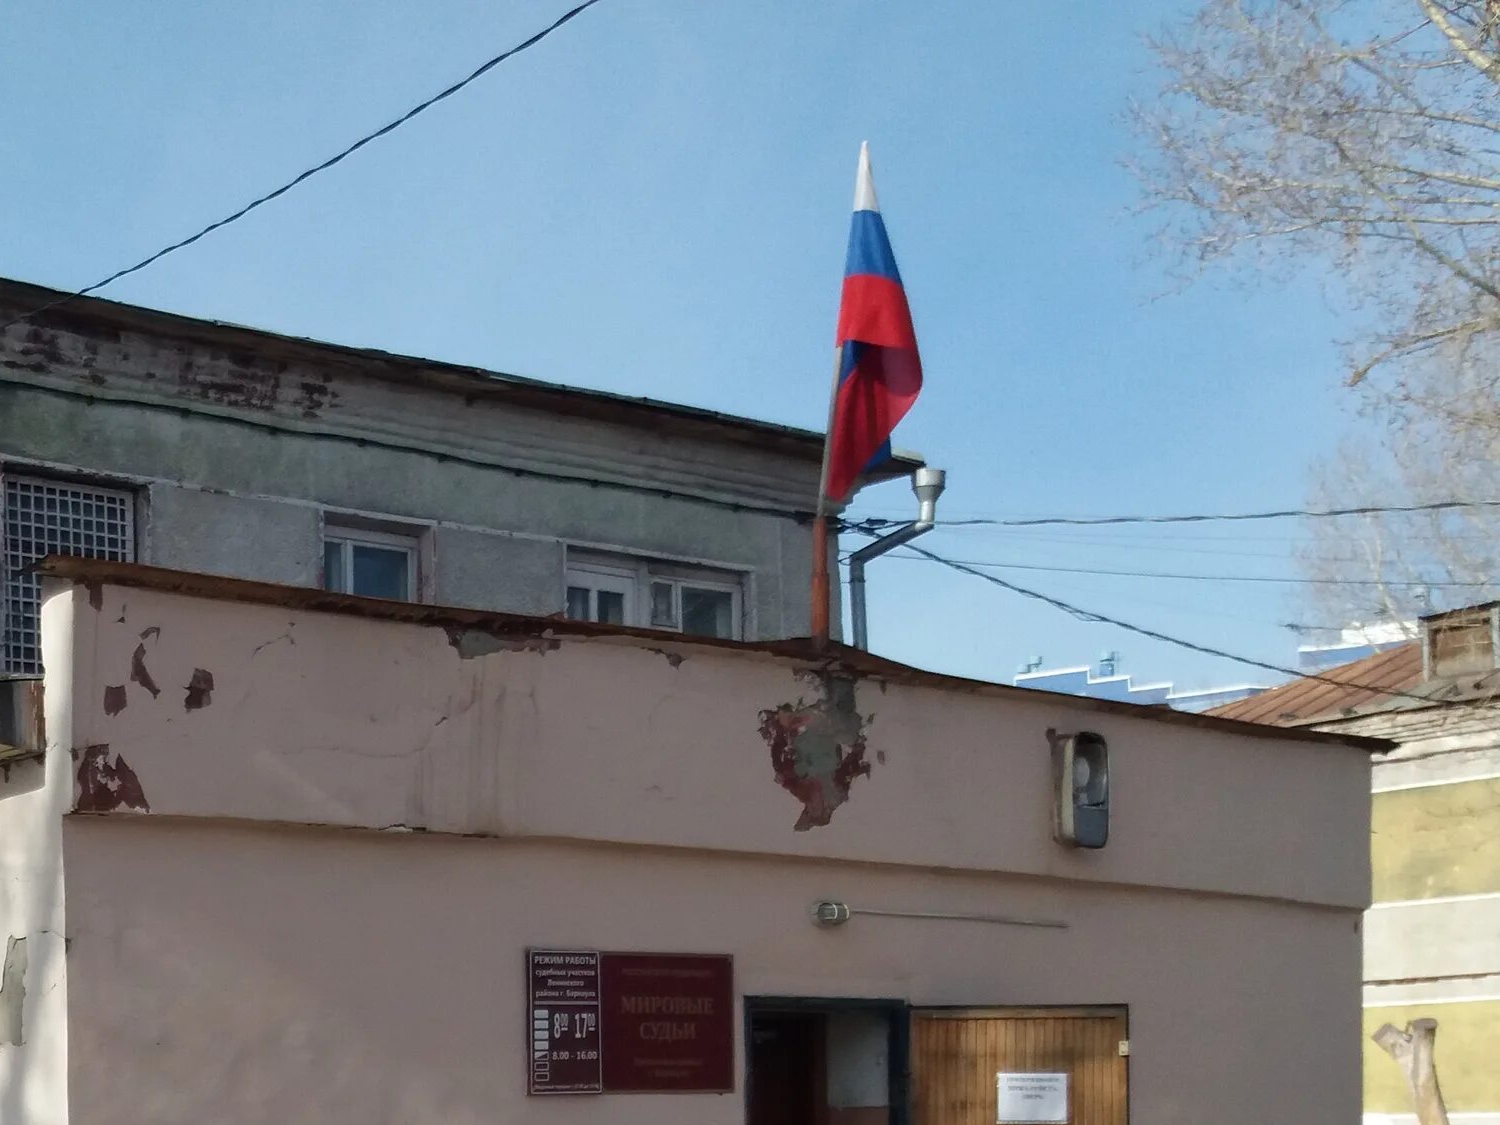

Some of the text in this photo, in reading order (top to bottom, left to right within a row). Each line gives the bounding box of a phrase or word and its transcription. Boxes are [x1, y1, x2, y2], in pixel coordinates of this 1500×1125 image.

[534, 956, 596, 965] РЕЖИМ РАБОТЫ
[620, 995, 715, 1015] МИРОВЫЕ
[639, 1022, 697, 1042] СУДЬИ
